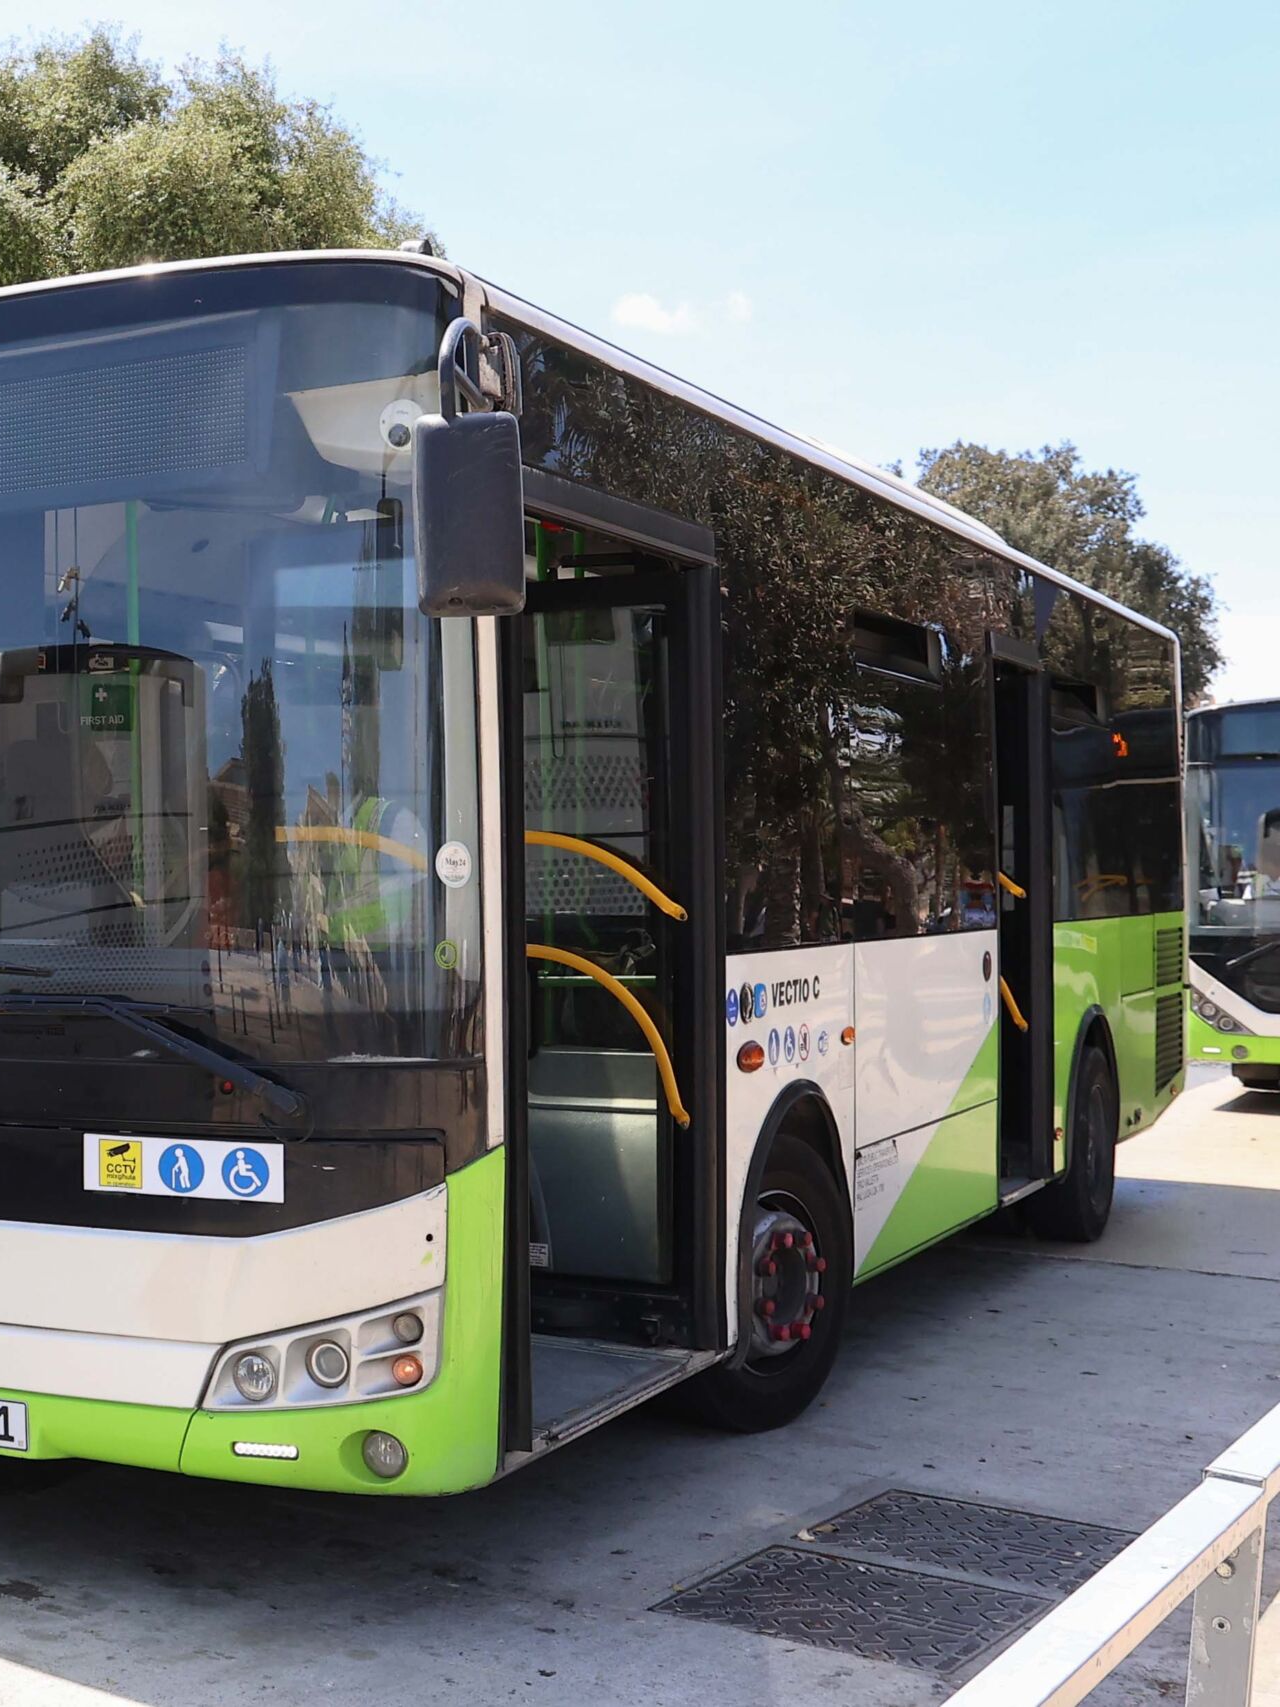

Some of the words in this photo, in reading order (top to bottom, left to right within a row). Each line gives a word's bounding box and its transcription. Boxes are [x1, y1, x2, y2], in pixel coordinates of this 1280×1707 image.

[80, 715, 107, 726] FIRST
[108, 714, 124, 725] AID
[771, 978, 810, 1008] VECTIO
[813, 975, 820, 999] C
[106, 1163, 136, 1173] CCTV
